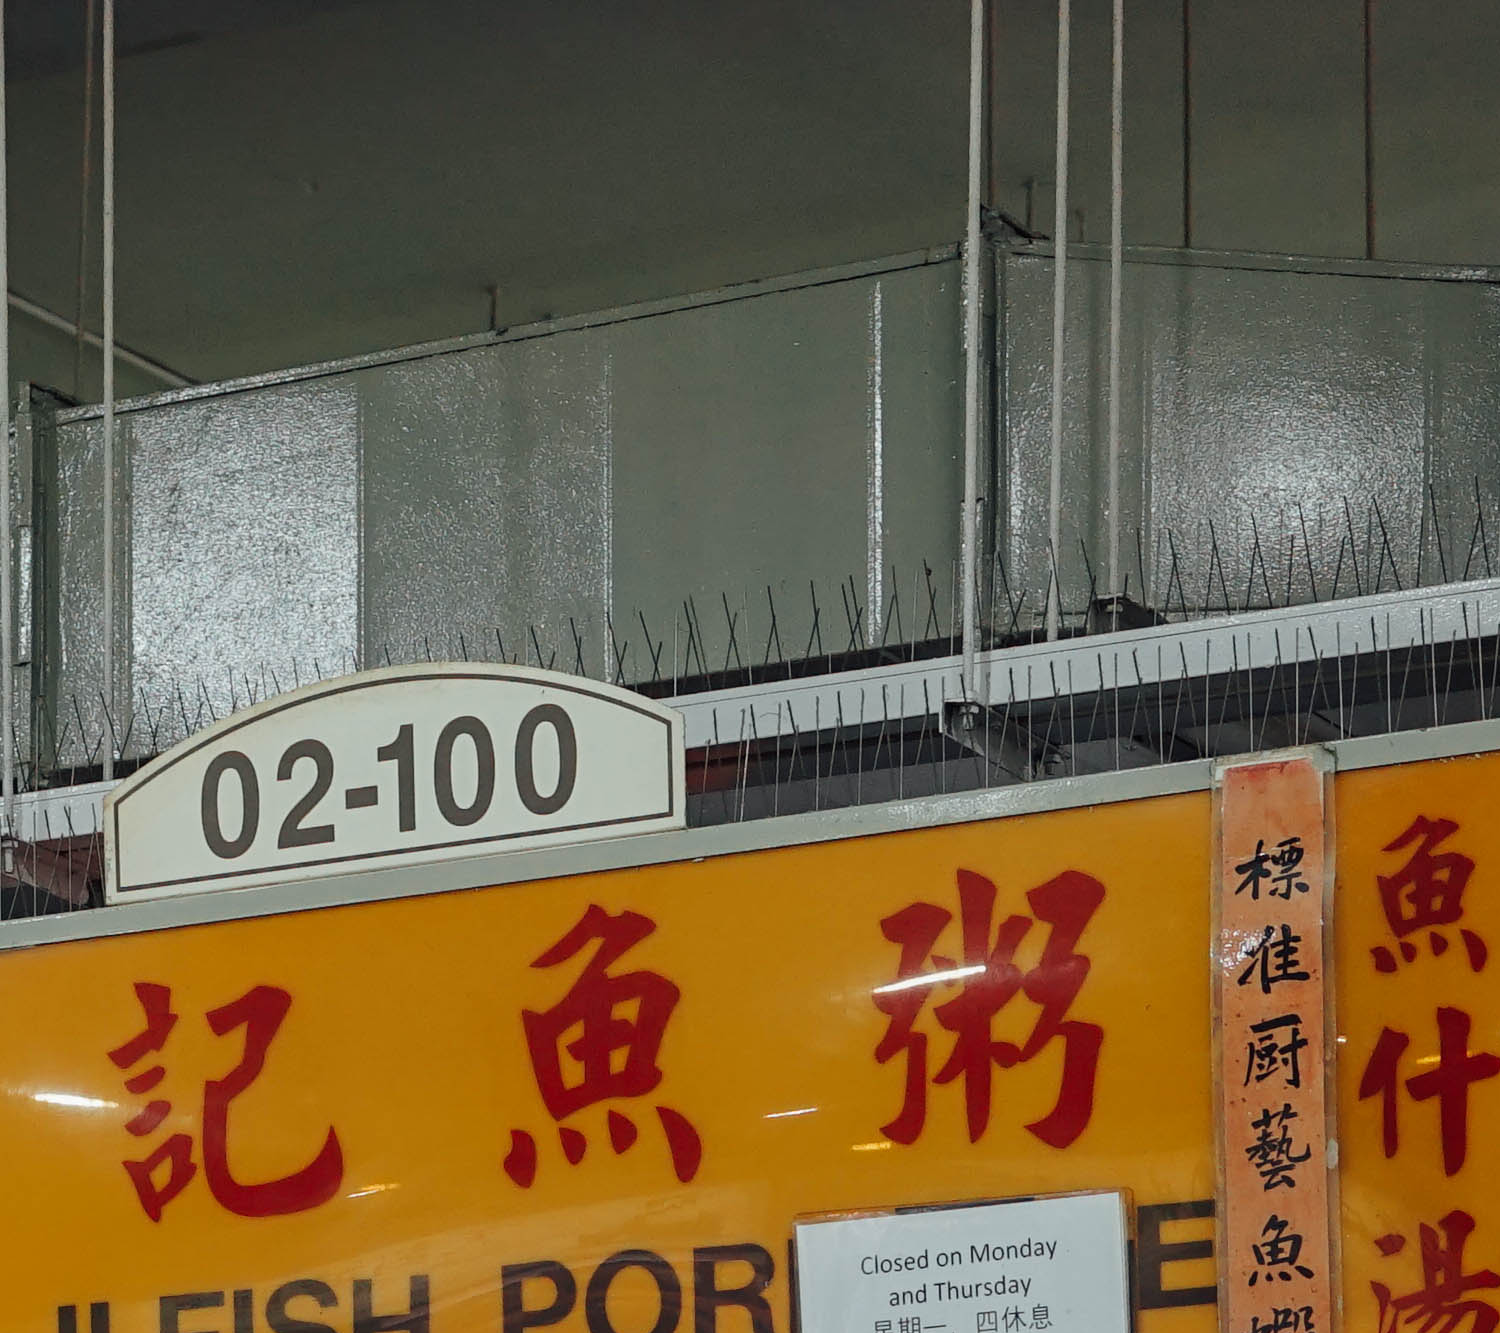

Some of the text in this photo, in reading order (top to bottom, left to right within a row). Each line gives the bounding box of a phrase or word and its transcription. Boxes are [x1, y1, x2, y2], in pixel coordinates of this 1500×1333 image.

[200, 700, 580, 861] 02-100
[860, 1237, 1058, 1276] Closed on Monday
[888, 1276, 1033, 1306] and Thursday
